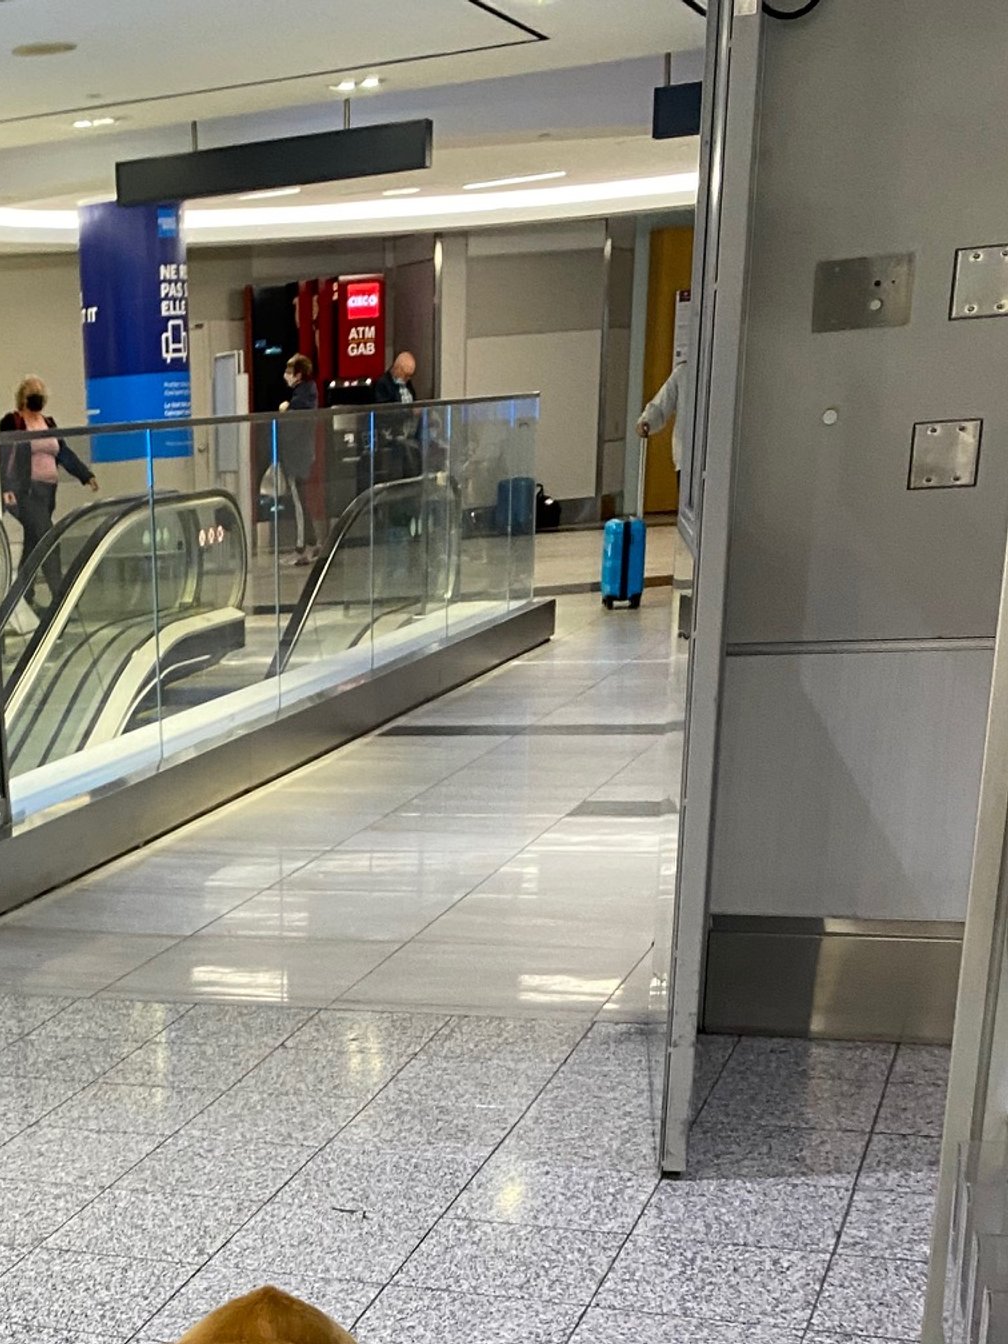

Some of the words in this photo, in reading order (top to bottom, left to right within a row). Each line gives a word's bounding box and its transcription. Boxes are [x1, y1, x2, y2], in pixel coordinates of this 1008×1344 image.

[160, 264, 178, 280] NE
[161, 282, 183, 298] PAS
[348, 326, 375, 340] ATM
[348, 342, 375, 356] GAB
